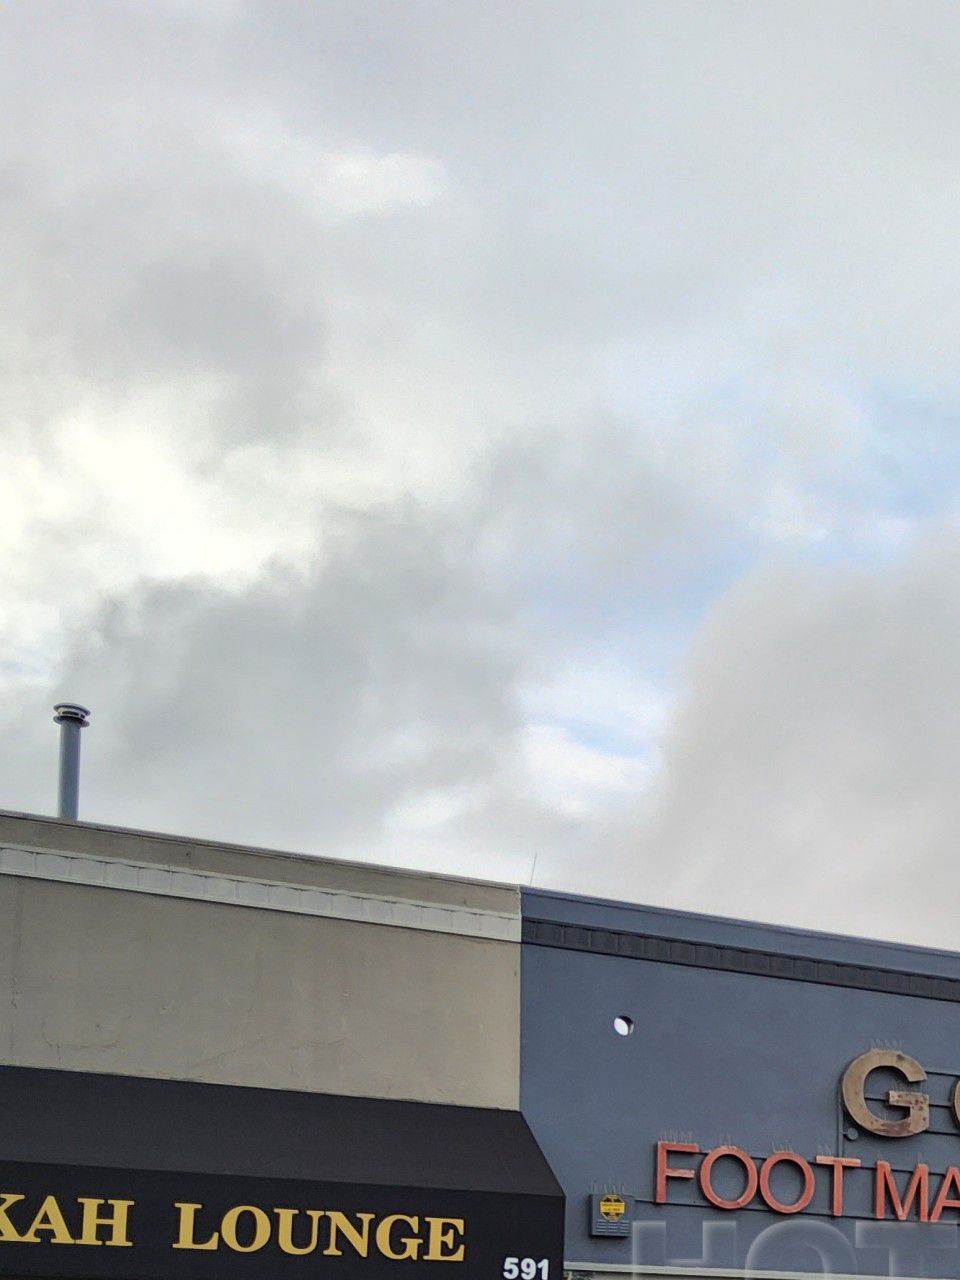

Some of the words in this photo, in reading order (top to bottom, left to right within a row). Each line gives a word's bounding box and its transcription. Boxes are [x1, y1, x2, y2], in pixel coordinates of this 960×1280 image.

[655, 1141, 861, 1217] FOOT
[172, 1202, 467, 1262] LOUNGE
[503, 1257, 550, 1280] 591
